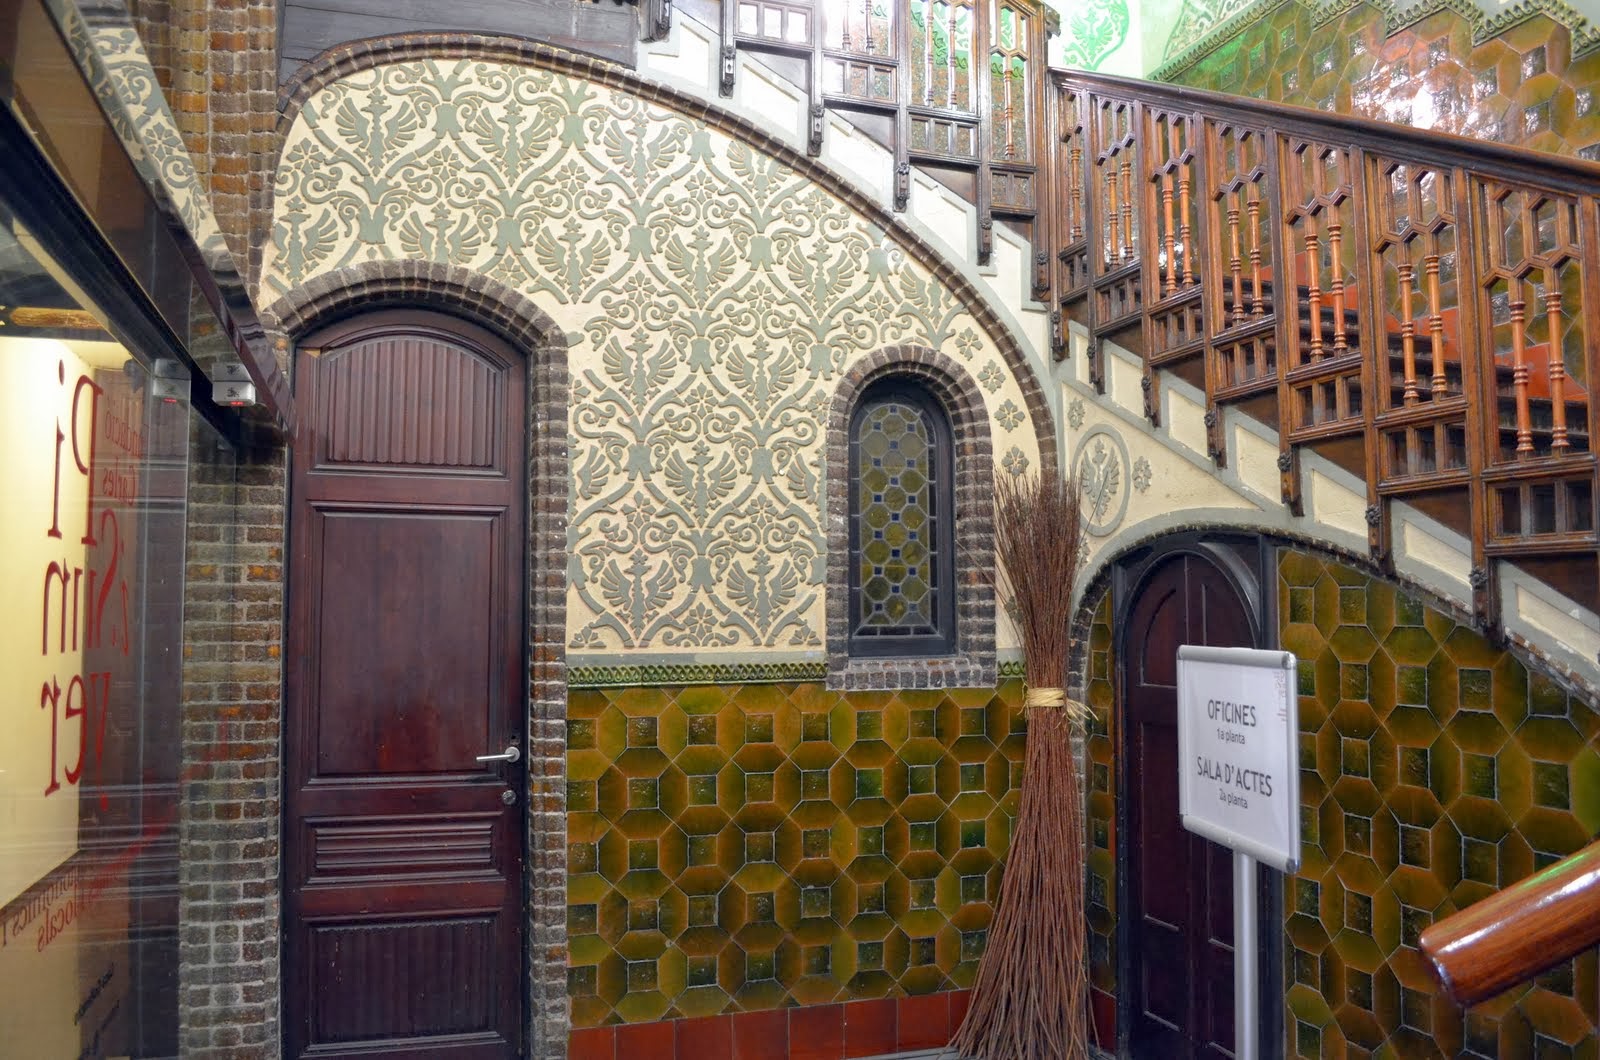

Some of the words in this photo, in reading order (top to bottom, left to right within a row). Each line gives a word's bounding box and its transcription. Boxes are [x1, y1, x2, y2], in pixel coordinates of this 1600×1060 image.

[1207, 699, 1257, 727] OFICINES
[1216, 727, 1225, 740] 1a
[1225, 730, 1246, 745] planta
[1197, 756, 1222, 782] SALA
[1225, 763, 1273, 797] D'ACTES
[1218, 787, 1227, 802] 2a
[1227, 791, 1248, 809] planta
